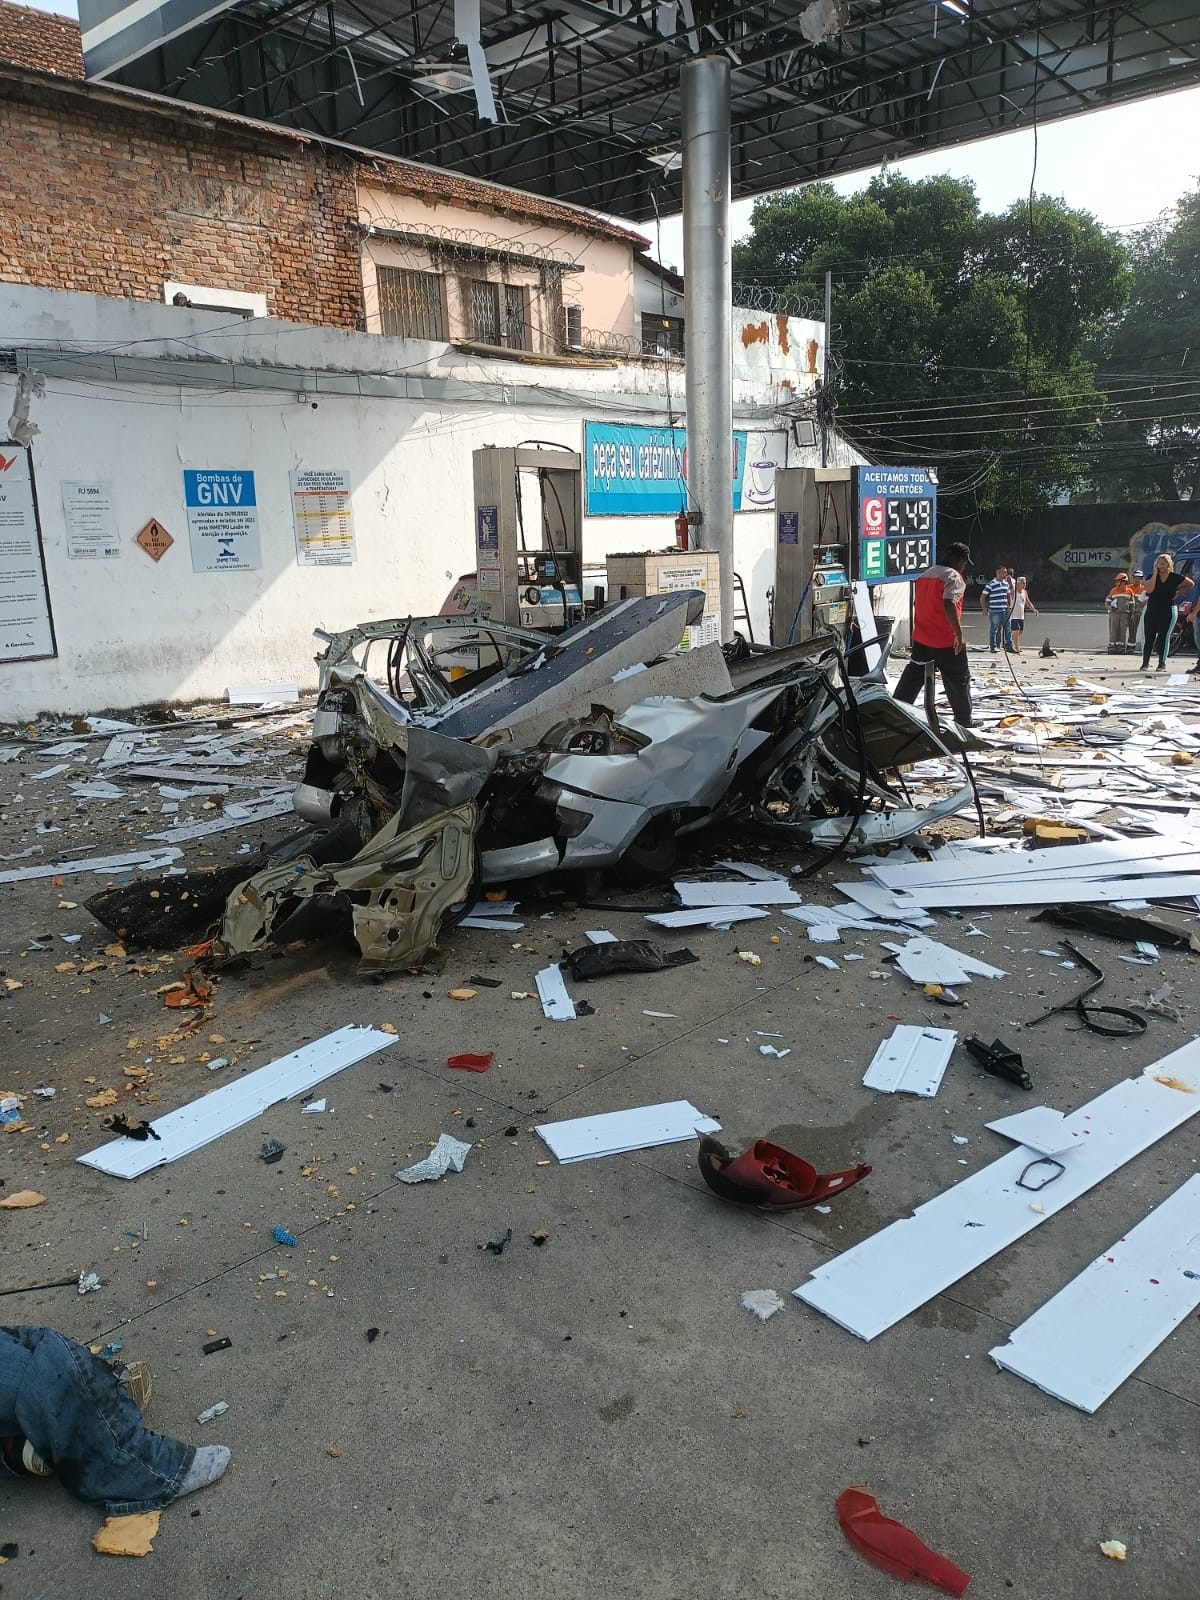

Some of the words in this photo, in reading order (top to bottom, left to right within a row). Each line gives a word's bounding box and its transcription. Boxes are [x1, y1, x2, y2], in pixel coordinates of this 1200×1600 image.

[196, 473, 230, 483] Bombas
[232, 474, 242, 483] de
[592, 441, 617, 492] peça
[619, 441, 636, 480] seu
[864, 472, 909, 482] ACEITAMOS
[910, 473, 930, 482] TODO
[197, 482, 243, 505] GNV
[877, 485, 888, 494] OS
[890, 484, 924, 494] CARTÕES
[865, 499, 882, 527] G
[888, 500, 930, 534] 5,49
[867, 541, 880, 569] E
[888, 539, 930, 574] 4,69
[1064, 550, 1086, 563] 800
[1088, 552, 1112, 561] MTS
